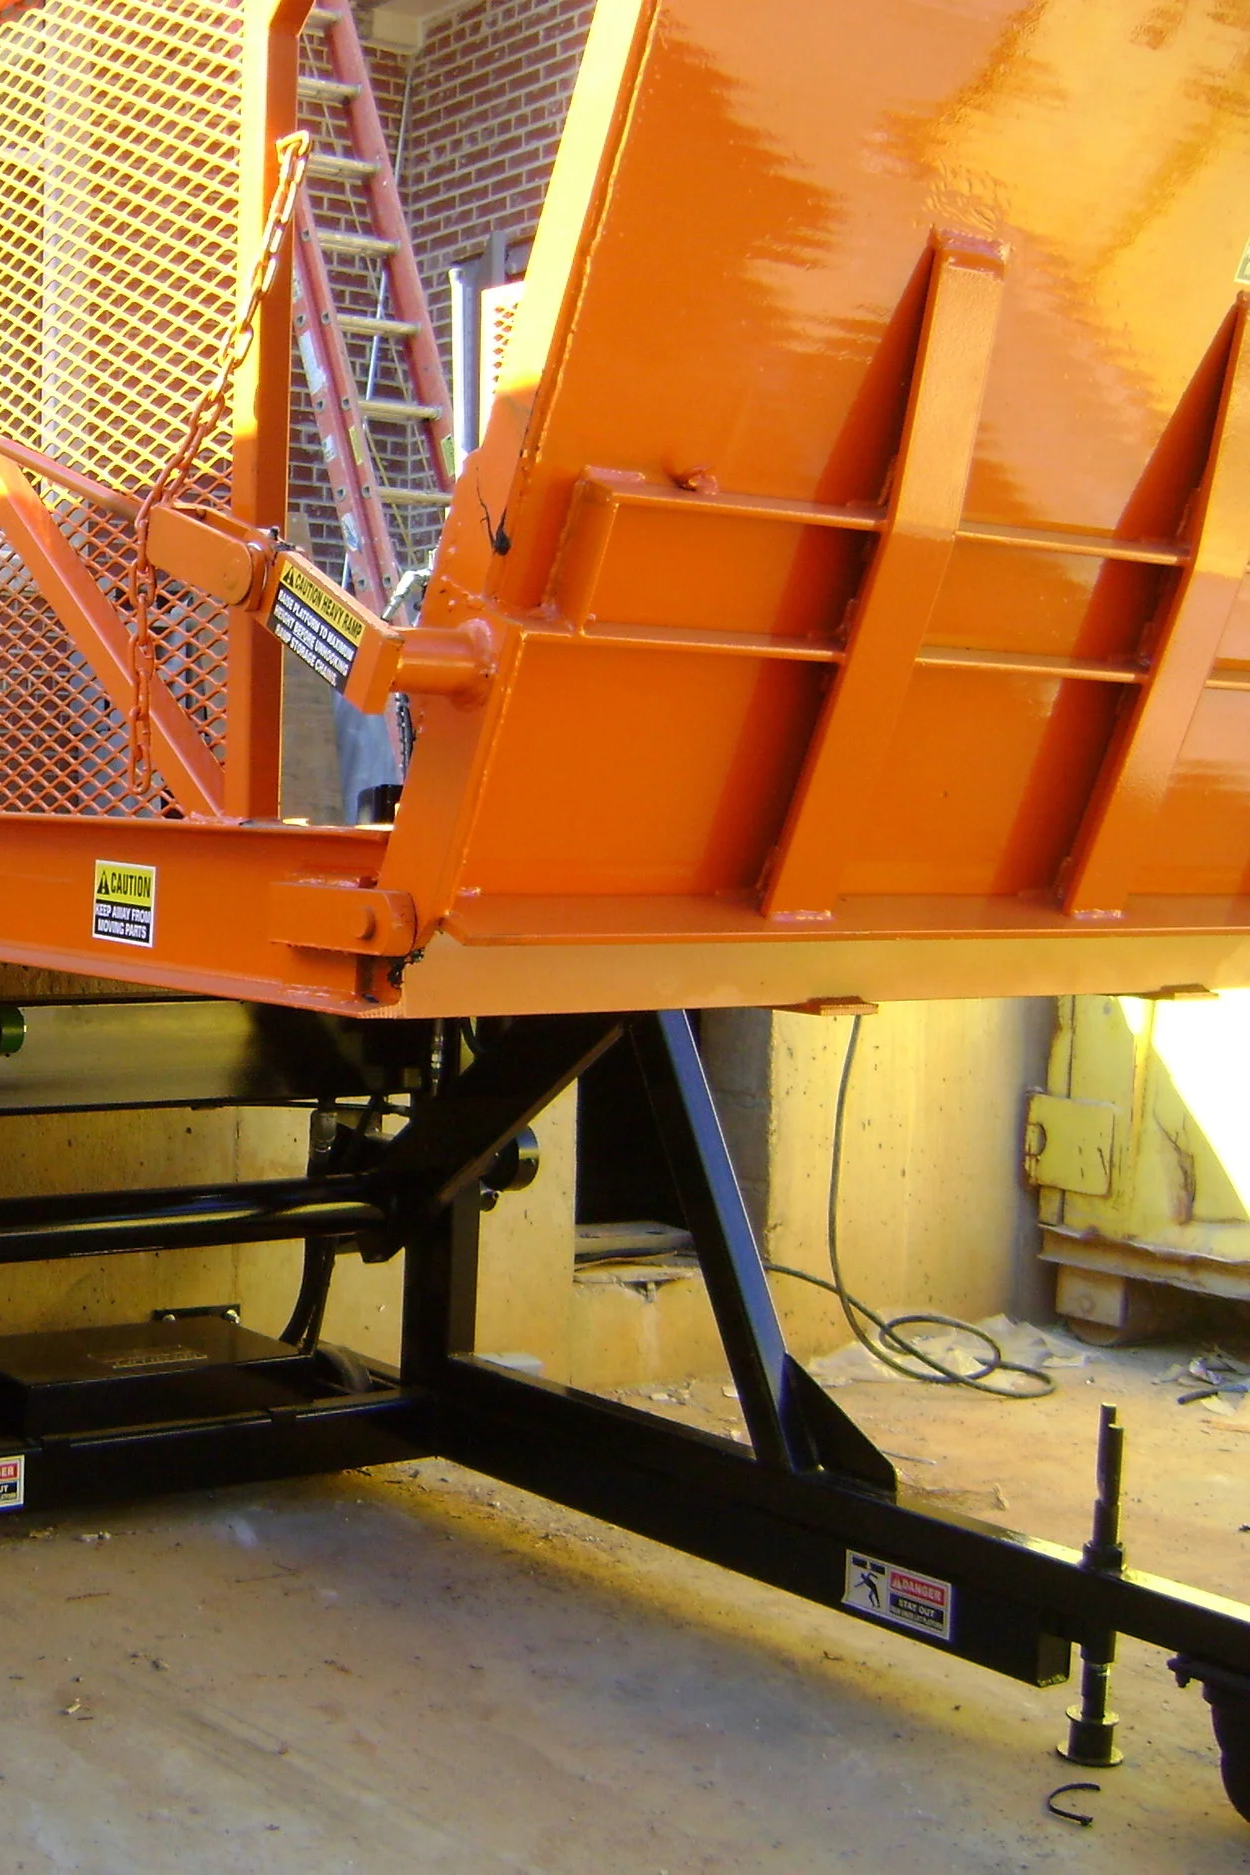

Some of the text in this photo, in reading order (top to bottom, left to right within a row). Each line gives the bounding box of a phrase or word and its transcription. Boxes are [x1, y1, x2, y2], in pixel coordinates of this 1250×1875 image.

[292, 599, 320, 634] PLATFORM
[294, 573, 363, 639] CAUTION HEAVY RAMP
[290, 638, 316, 668] STORAGE
[111, 872, 151, 898] CAUTION
[96, 903, 151, 923] KEEP AWAY FROM
[97, 919, 147, 939] MOVING PARTS
[902, 1578, 942, 1602] DANGER
[897, 1598, 935, 1617] STAY OUT
